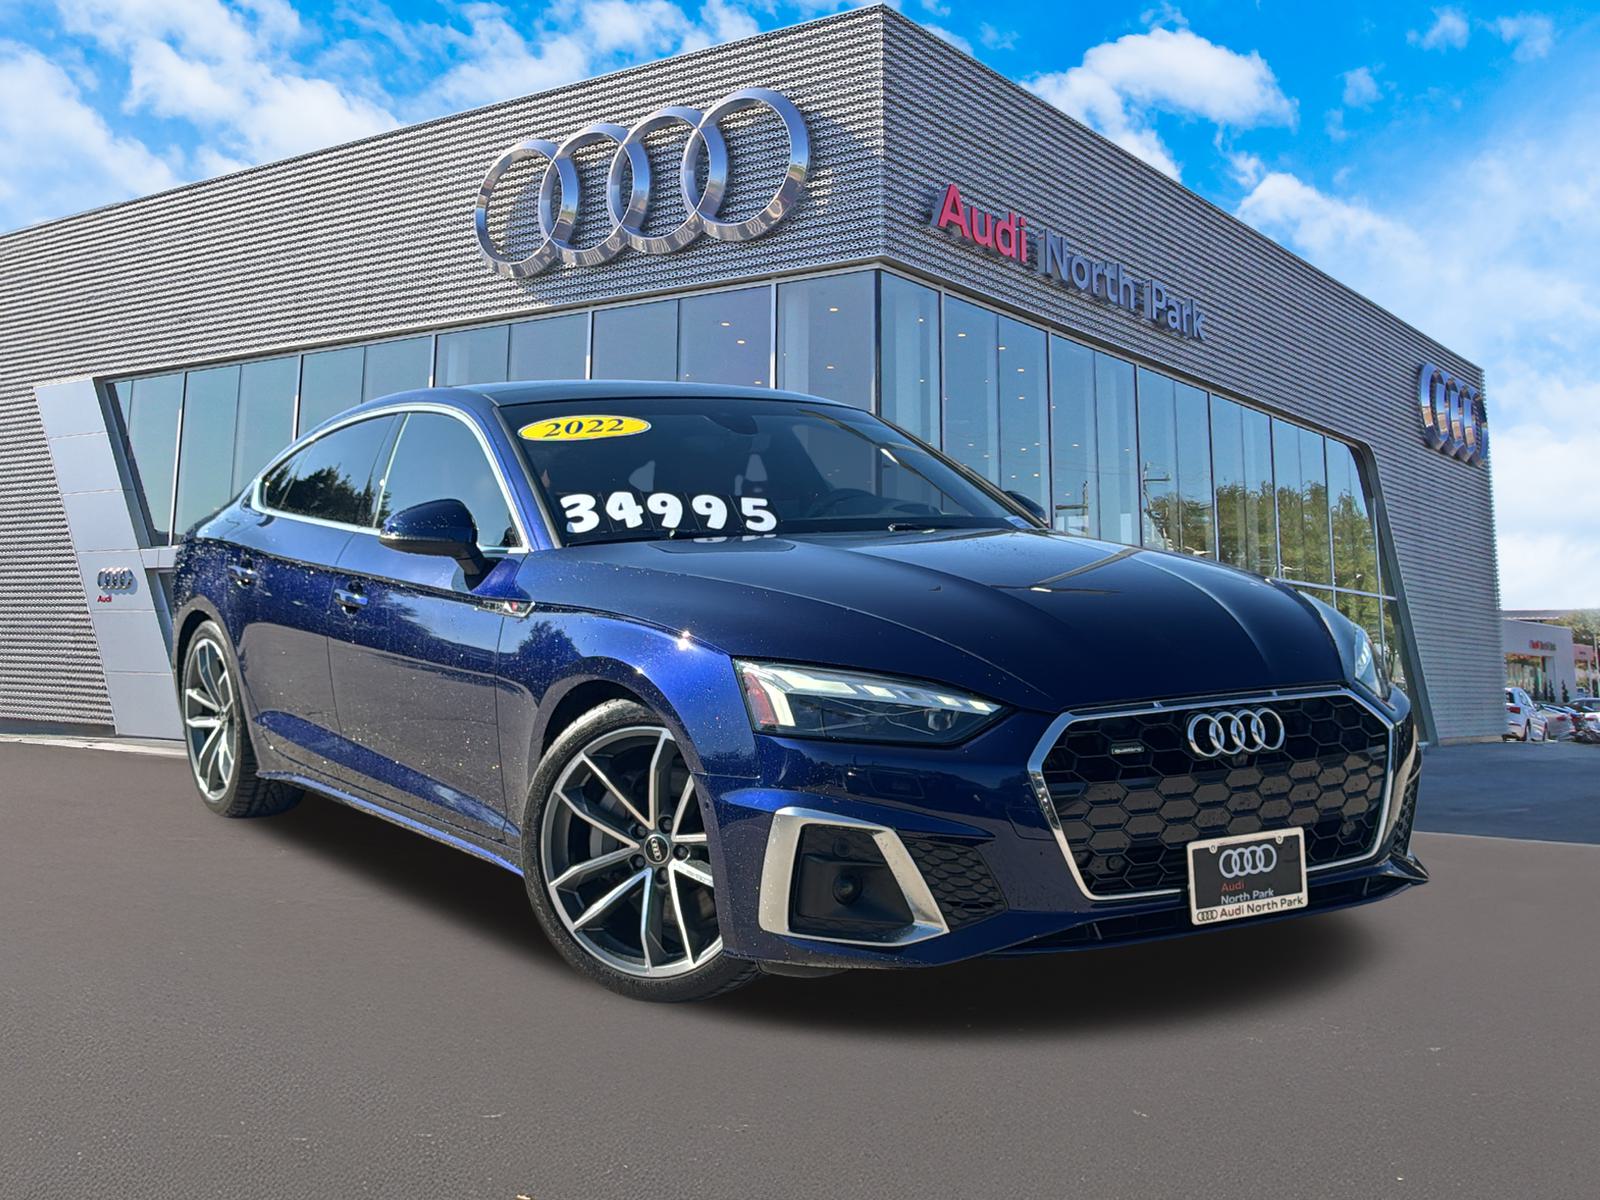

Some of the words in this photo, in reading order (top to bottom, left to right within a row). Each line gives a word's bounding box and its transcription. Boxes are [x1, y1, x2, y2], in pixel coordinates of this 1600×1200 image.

[932, 184, 1028, 263] Audi
[1039, 229, 1137, 311] North
[1146, 279, 1208, 341] Park
[544, 419, 624, 437] 2022
[560, 491, 777, 533] 34995
[97, 594, 112, 603] Audi
[1221, 880, 1245, 892] Audi
[1221, 891, 1250, 904] North
[1252, 888, 1275, 899] Park
[1220, 904, 1245, 918] Audi
[1246, 899, 1278, 913] North
[1280, 895, 1304, 908] Park
